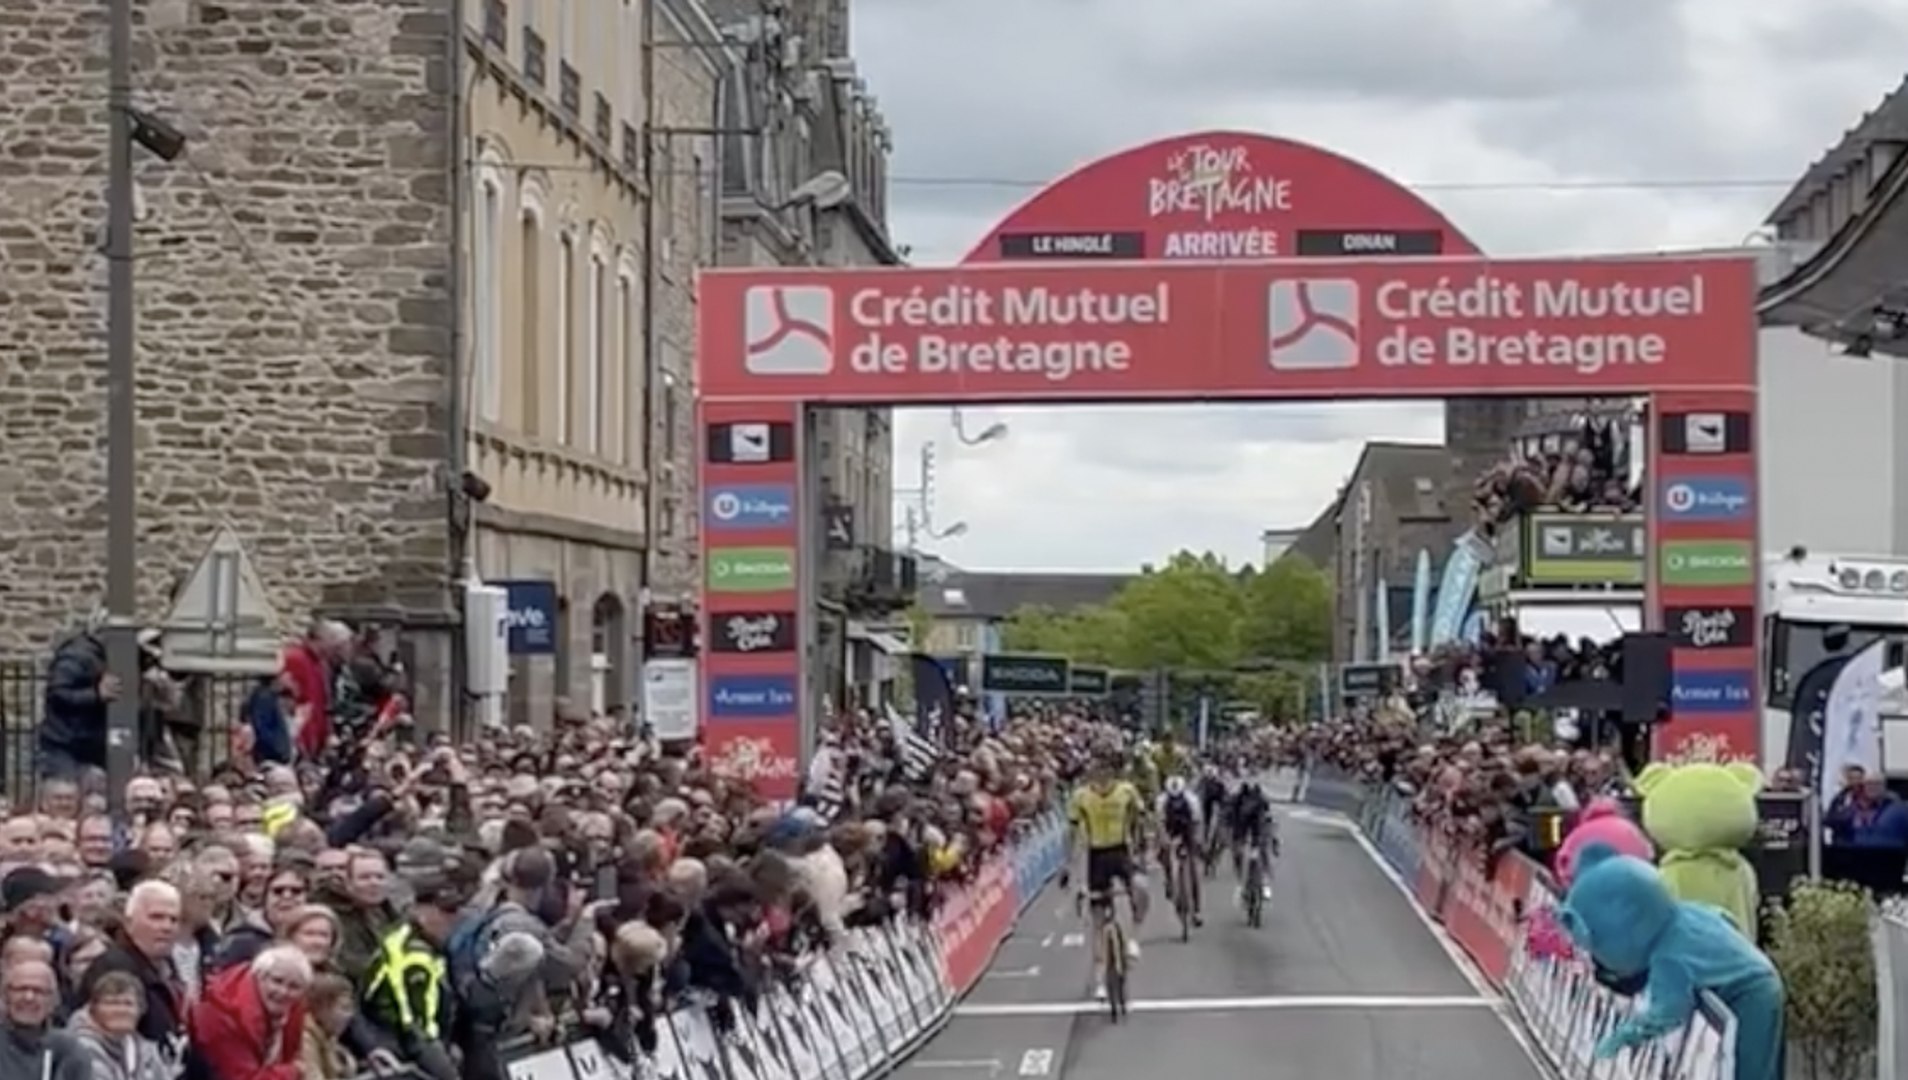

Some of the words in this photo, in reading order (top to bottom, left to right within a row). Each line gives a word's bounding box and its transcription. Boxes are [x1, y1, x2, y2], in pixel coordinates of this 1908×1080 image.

[1187, 143, 1252, 172] TOUR
[1149, 175, 1293, 222] BRETAGNE
[1033, 235, 1052, 253] LE
[1164, 226, 1278, 257] ARRIVÉE
[1343, 232, 1396, 250] DINAN
[851, 284, 995, 327] Crédit
[1003, 281, 1169, 325] Mutuel
[1376, 276, 1523, 320] Crédit
[1533, 274, 1704, 317] Mutuel
[851, 333, 907, 373] de
[918, 333, 1132, 379] Bretagne
[1376, 326, 1435, 366] de
[1447, 327, 1666, 375] Bretagne
